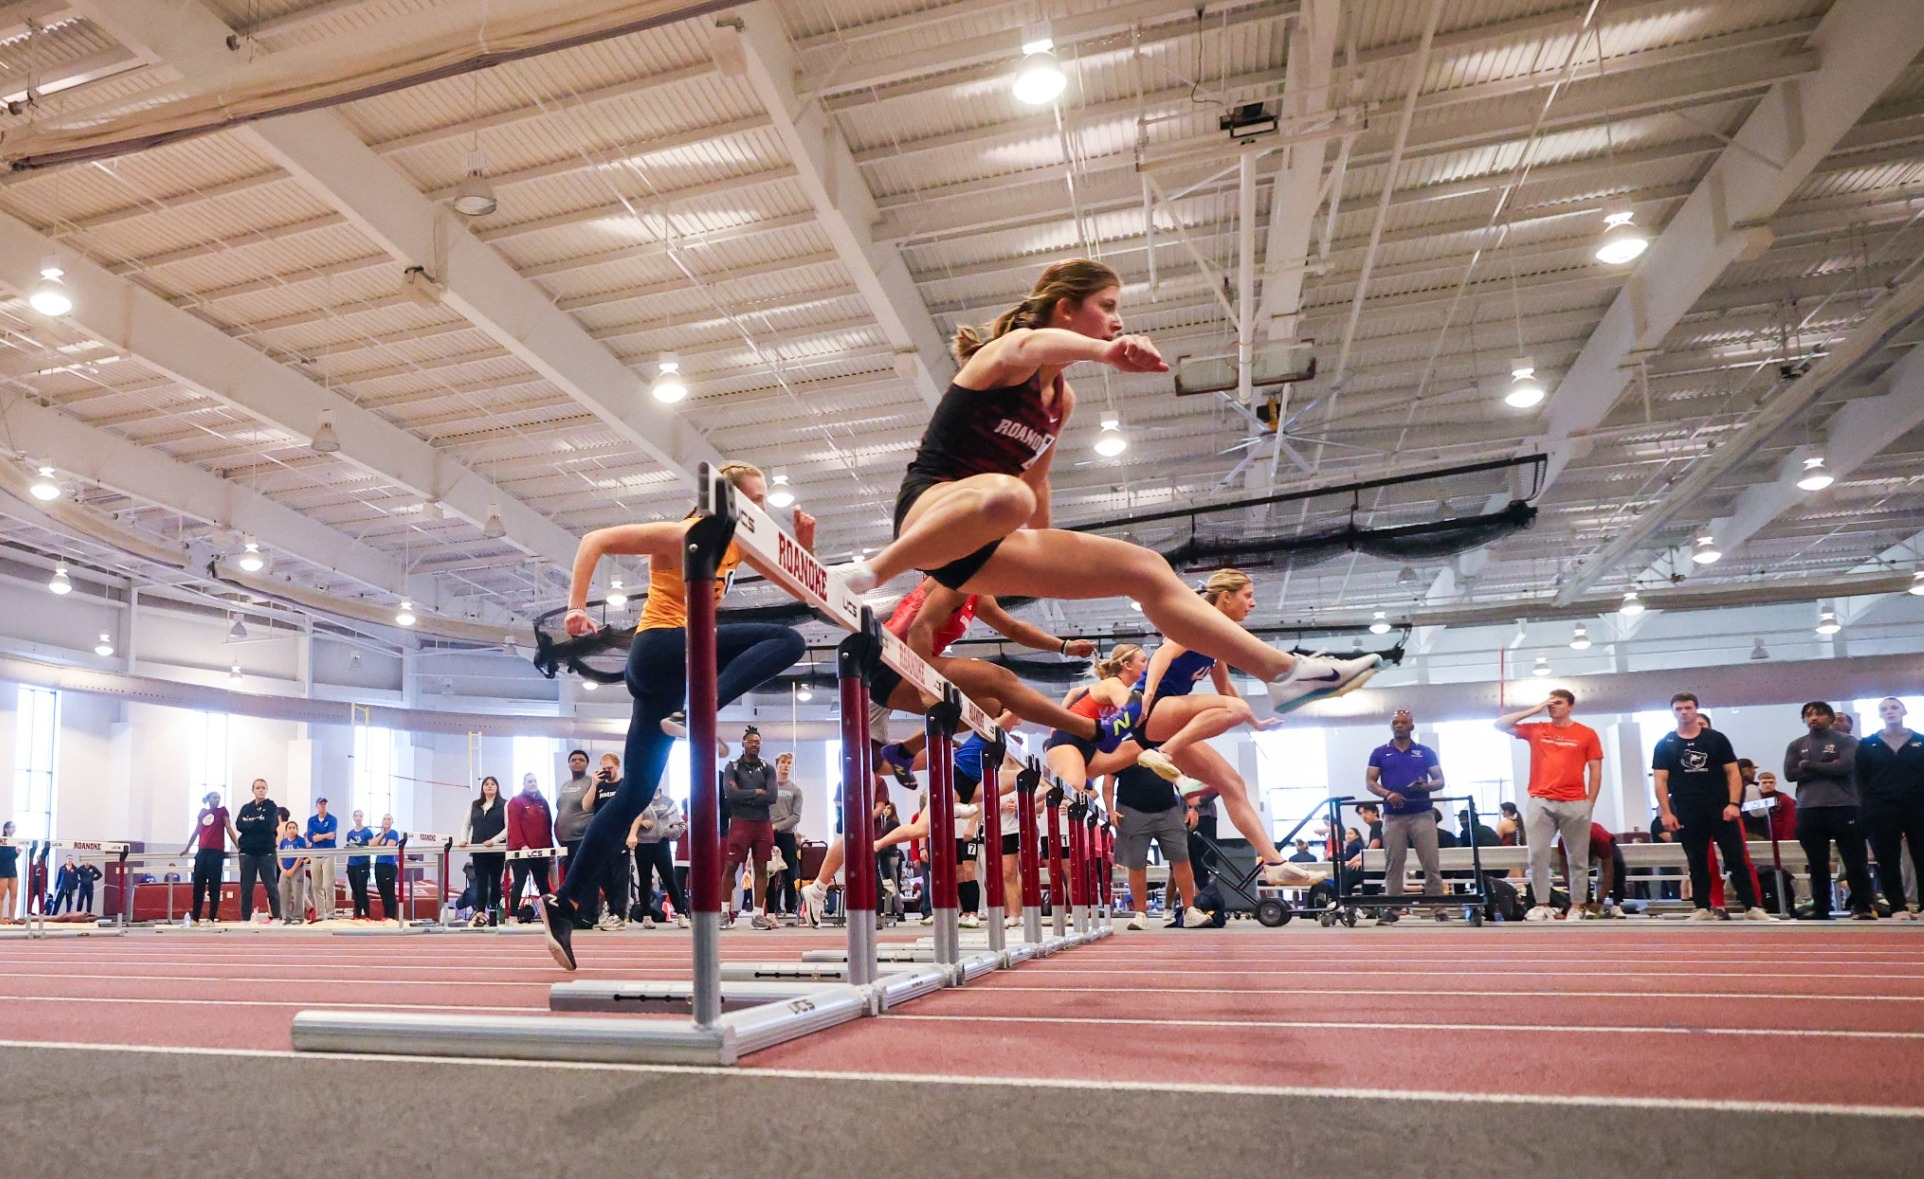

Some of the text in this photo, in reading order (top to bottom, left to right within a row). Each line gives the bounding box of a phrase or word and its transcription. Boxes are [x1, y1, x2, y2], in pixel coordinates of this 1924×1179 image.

[993, 418, 1047, 452] ROANO
[737, 507, 755, 534] CS
[778, 531, 828, 602] ROANOKE
[842, 595, 858, 618] UCS
[73, 841, 102, 851] ROANOKE
[526, 850, 544, 858] UCS
